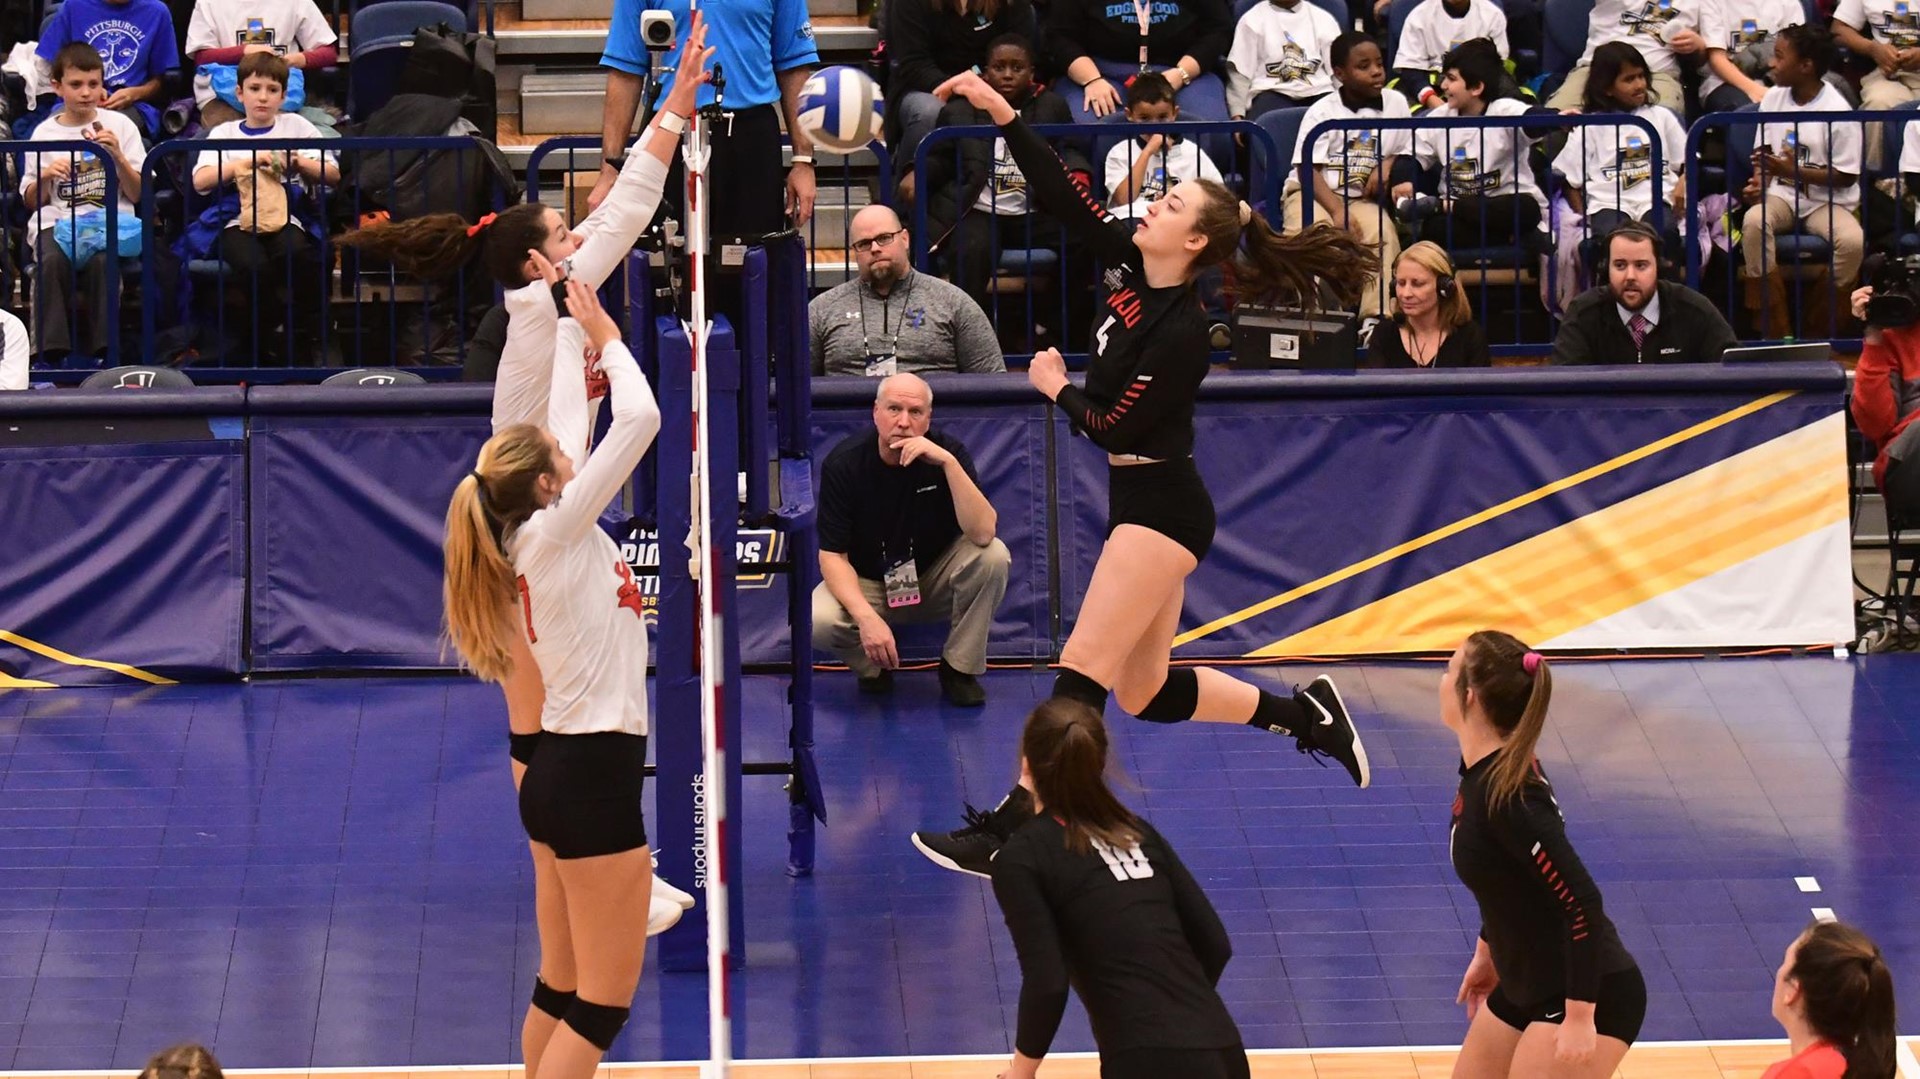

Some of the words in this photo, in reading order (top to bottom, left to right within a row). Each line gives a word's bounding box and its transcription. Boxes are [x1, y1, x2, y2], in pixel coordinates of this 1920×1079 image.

[1105, 2, 1180, 17] EDGEOOD
[1121, 15, 1168, 24] PRIARY
[84, 20, 146, 40] PITTSBURGH
[1106, 288, 1143, 329] WJU
[1096, 314, 1117, 357] 4
[1089, 836, 1154, 881] 10
